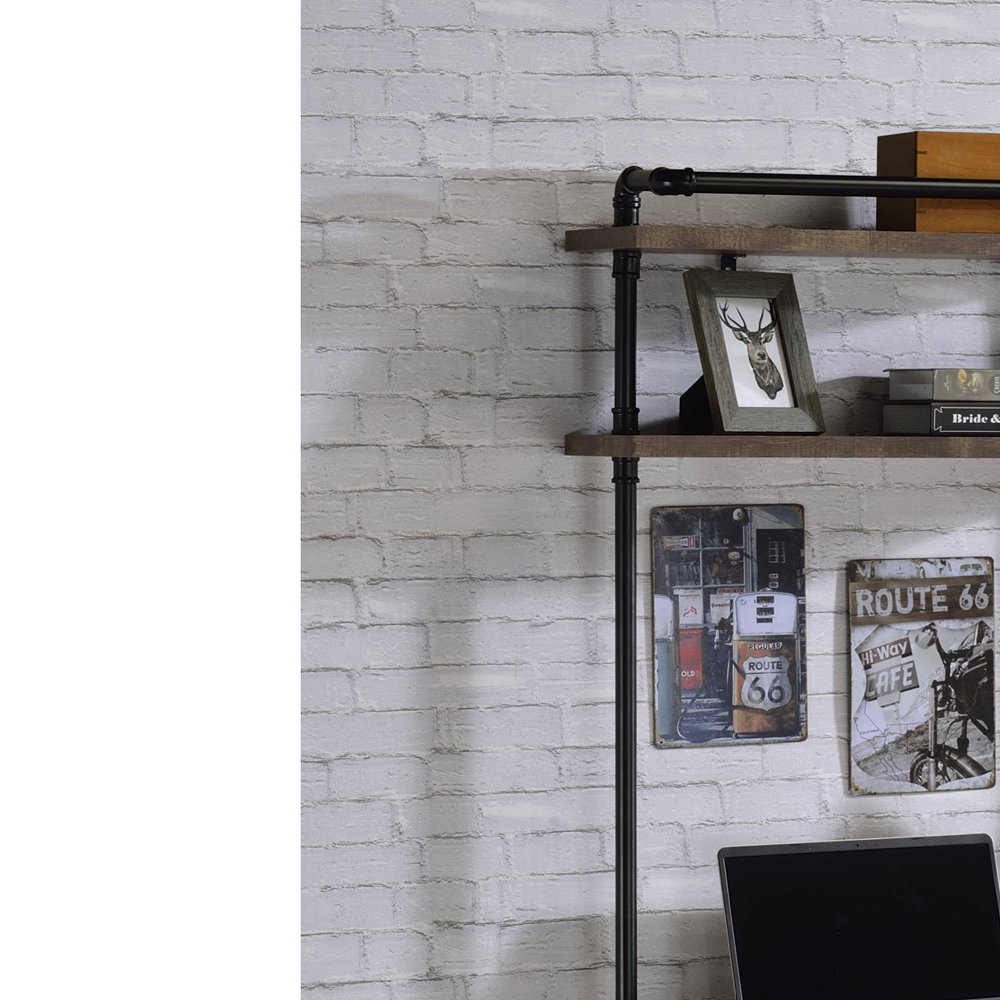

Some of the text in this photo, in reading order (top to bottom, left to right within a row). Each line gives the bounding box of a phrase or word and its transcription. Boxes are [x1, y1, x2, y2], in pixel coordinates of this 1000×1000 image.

[952, 413, 988, 424] Bride
[855, 582, 989, 618] ROUTE 66
[748, 641, 783, 650] REGULAR
[860, 640, 908, 666] Hi-Way
[748, 661, 783, 671] ROUTE
[748, 676, 784, 704] 66
[866, 663, 914, 696] CAFE
